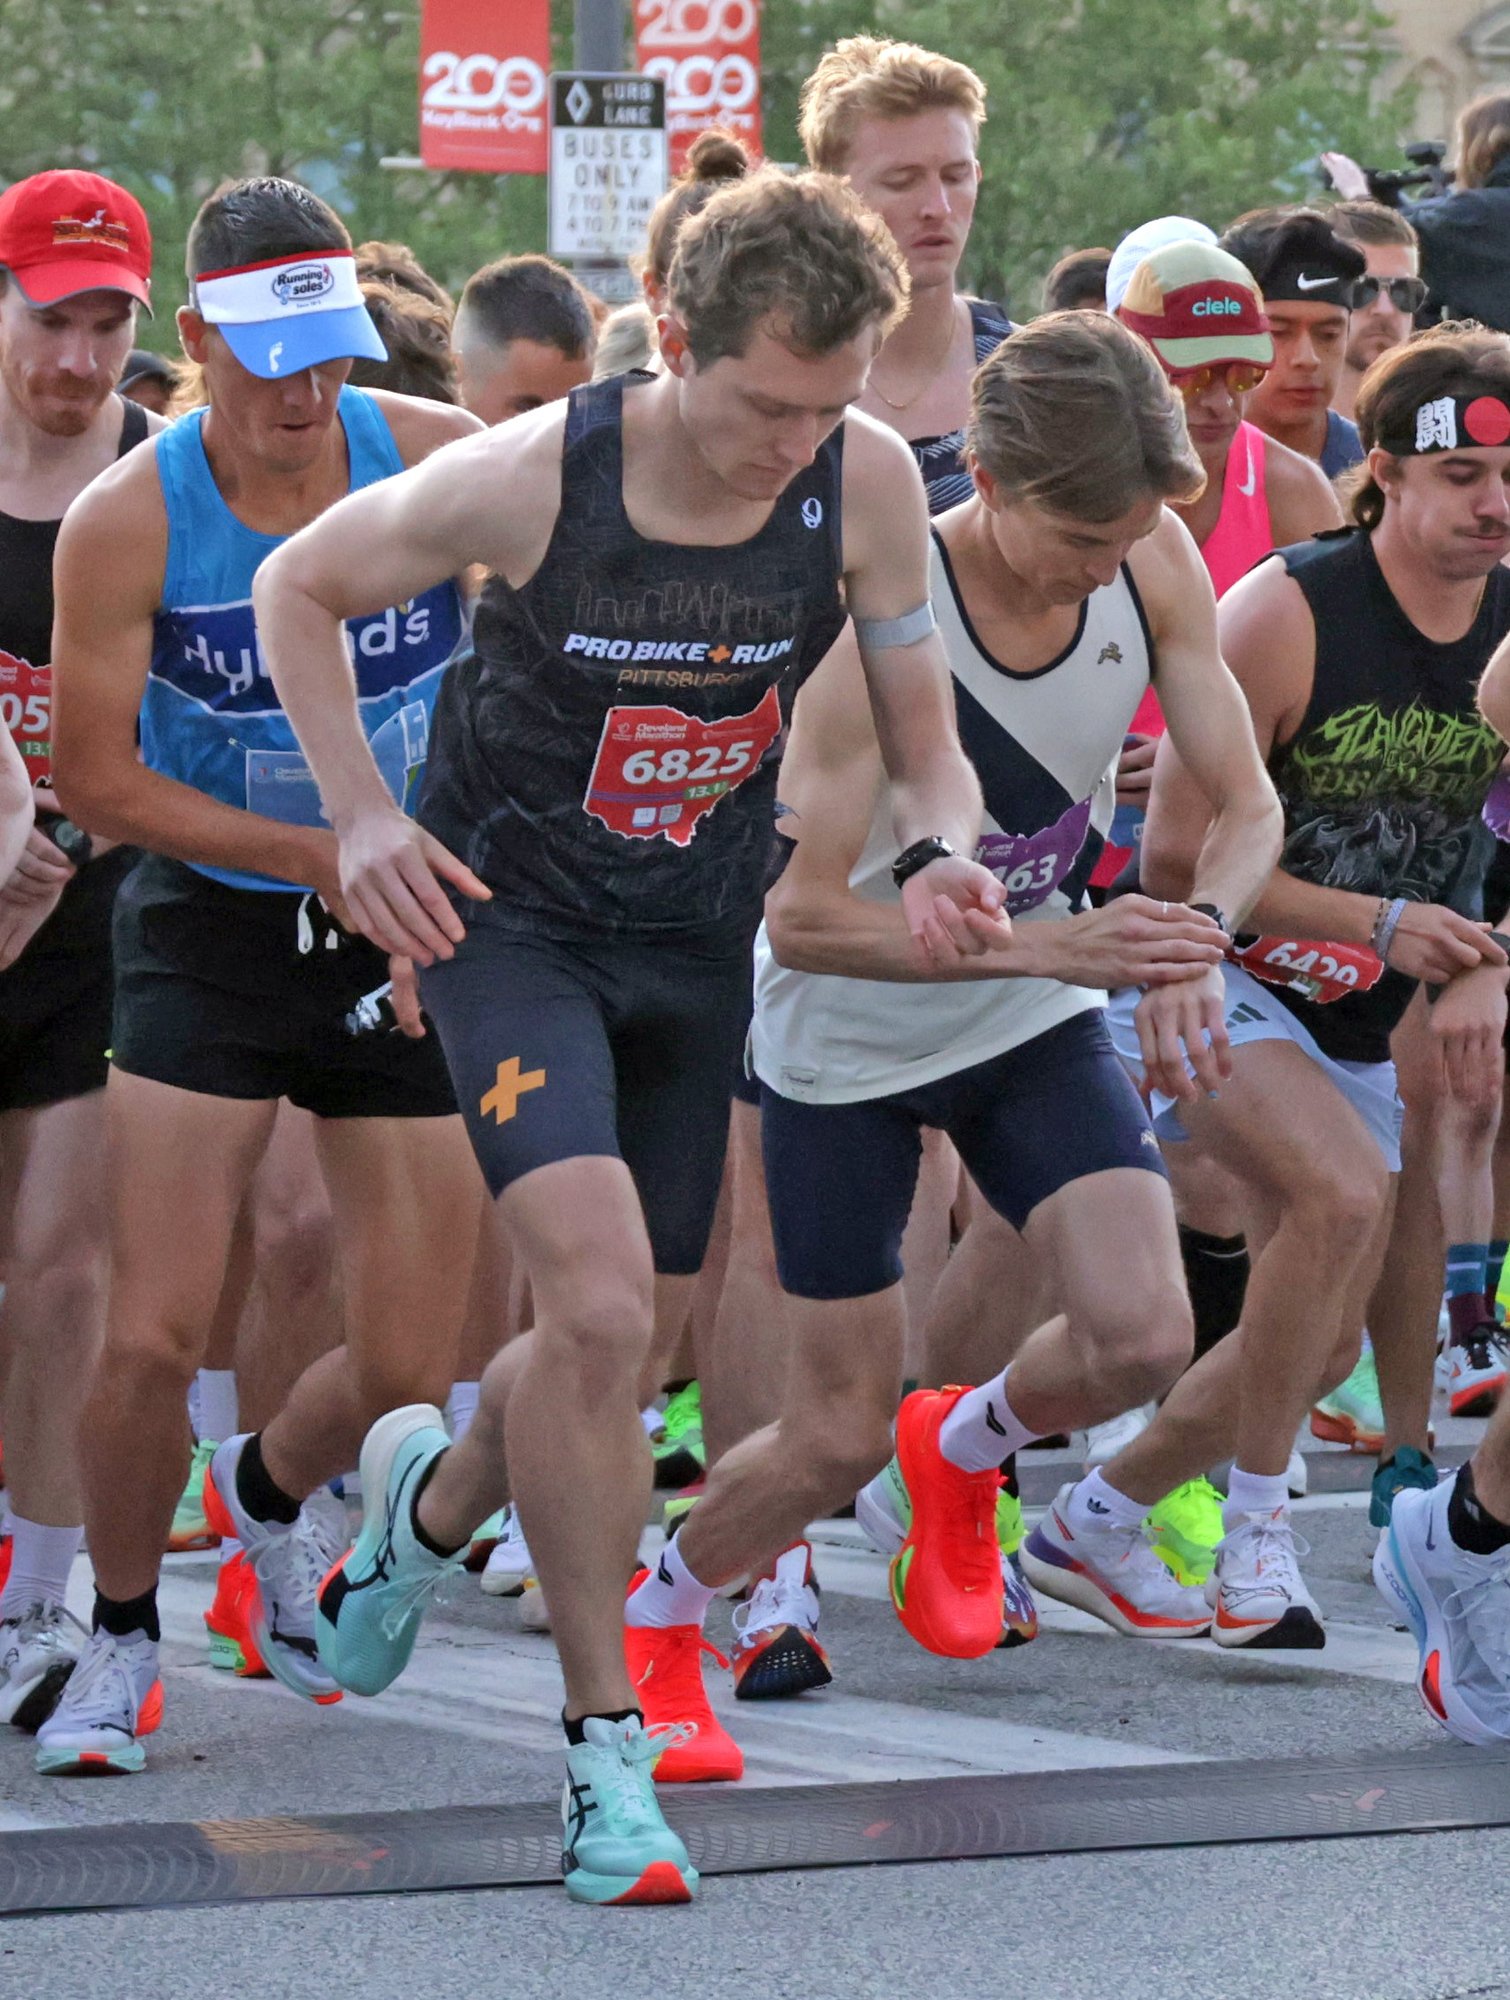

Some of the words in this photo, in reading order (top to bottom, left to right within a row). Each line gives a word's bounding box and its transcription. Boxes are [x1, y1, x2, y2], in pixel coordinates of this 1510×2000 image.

[638, 0, 756, 45] 200
[423, 51, 546, 111] 200
[602, 82, 655, 100] CURB
[604, 105, 651, 125] LANE
[564, 133, 652, 159] BUSES
[574, 163, 640, 188] ONLY
[277, 270, 323, 286] Running
[293, 280, 323, 295] soles
[1191, 297, 1242, 316] ciele
[622, 741, 755, 785] 6825
